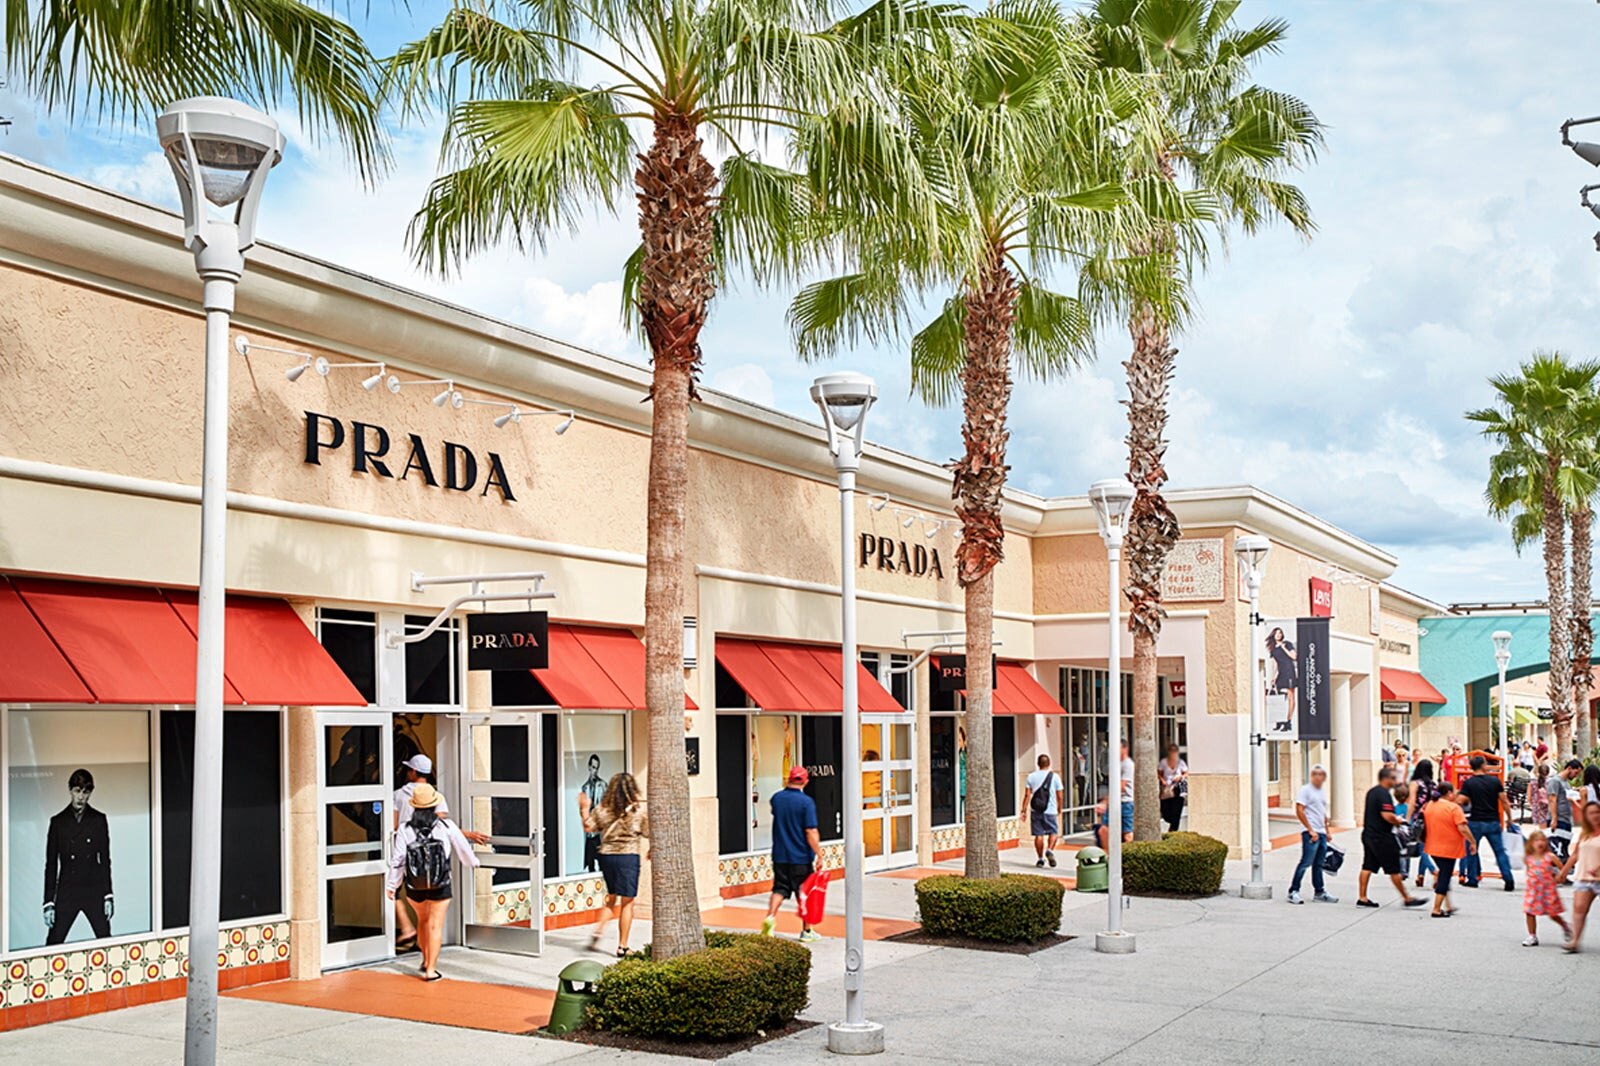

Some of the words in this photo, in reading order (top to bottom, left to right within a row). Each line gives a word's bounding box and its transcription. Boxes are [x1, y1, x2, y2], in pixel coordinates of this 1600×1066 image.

[303, 410, 518, 502] PRADA
[861, 532, 944, 579] PRADA
[472, 632, 539, 649] PRADA
[1309, 679, 1317, 716] VINELAND
[806, 764, 835, 777] PRADA
